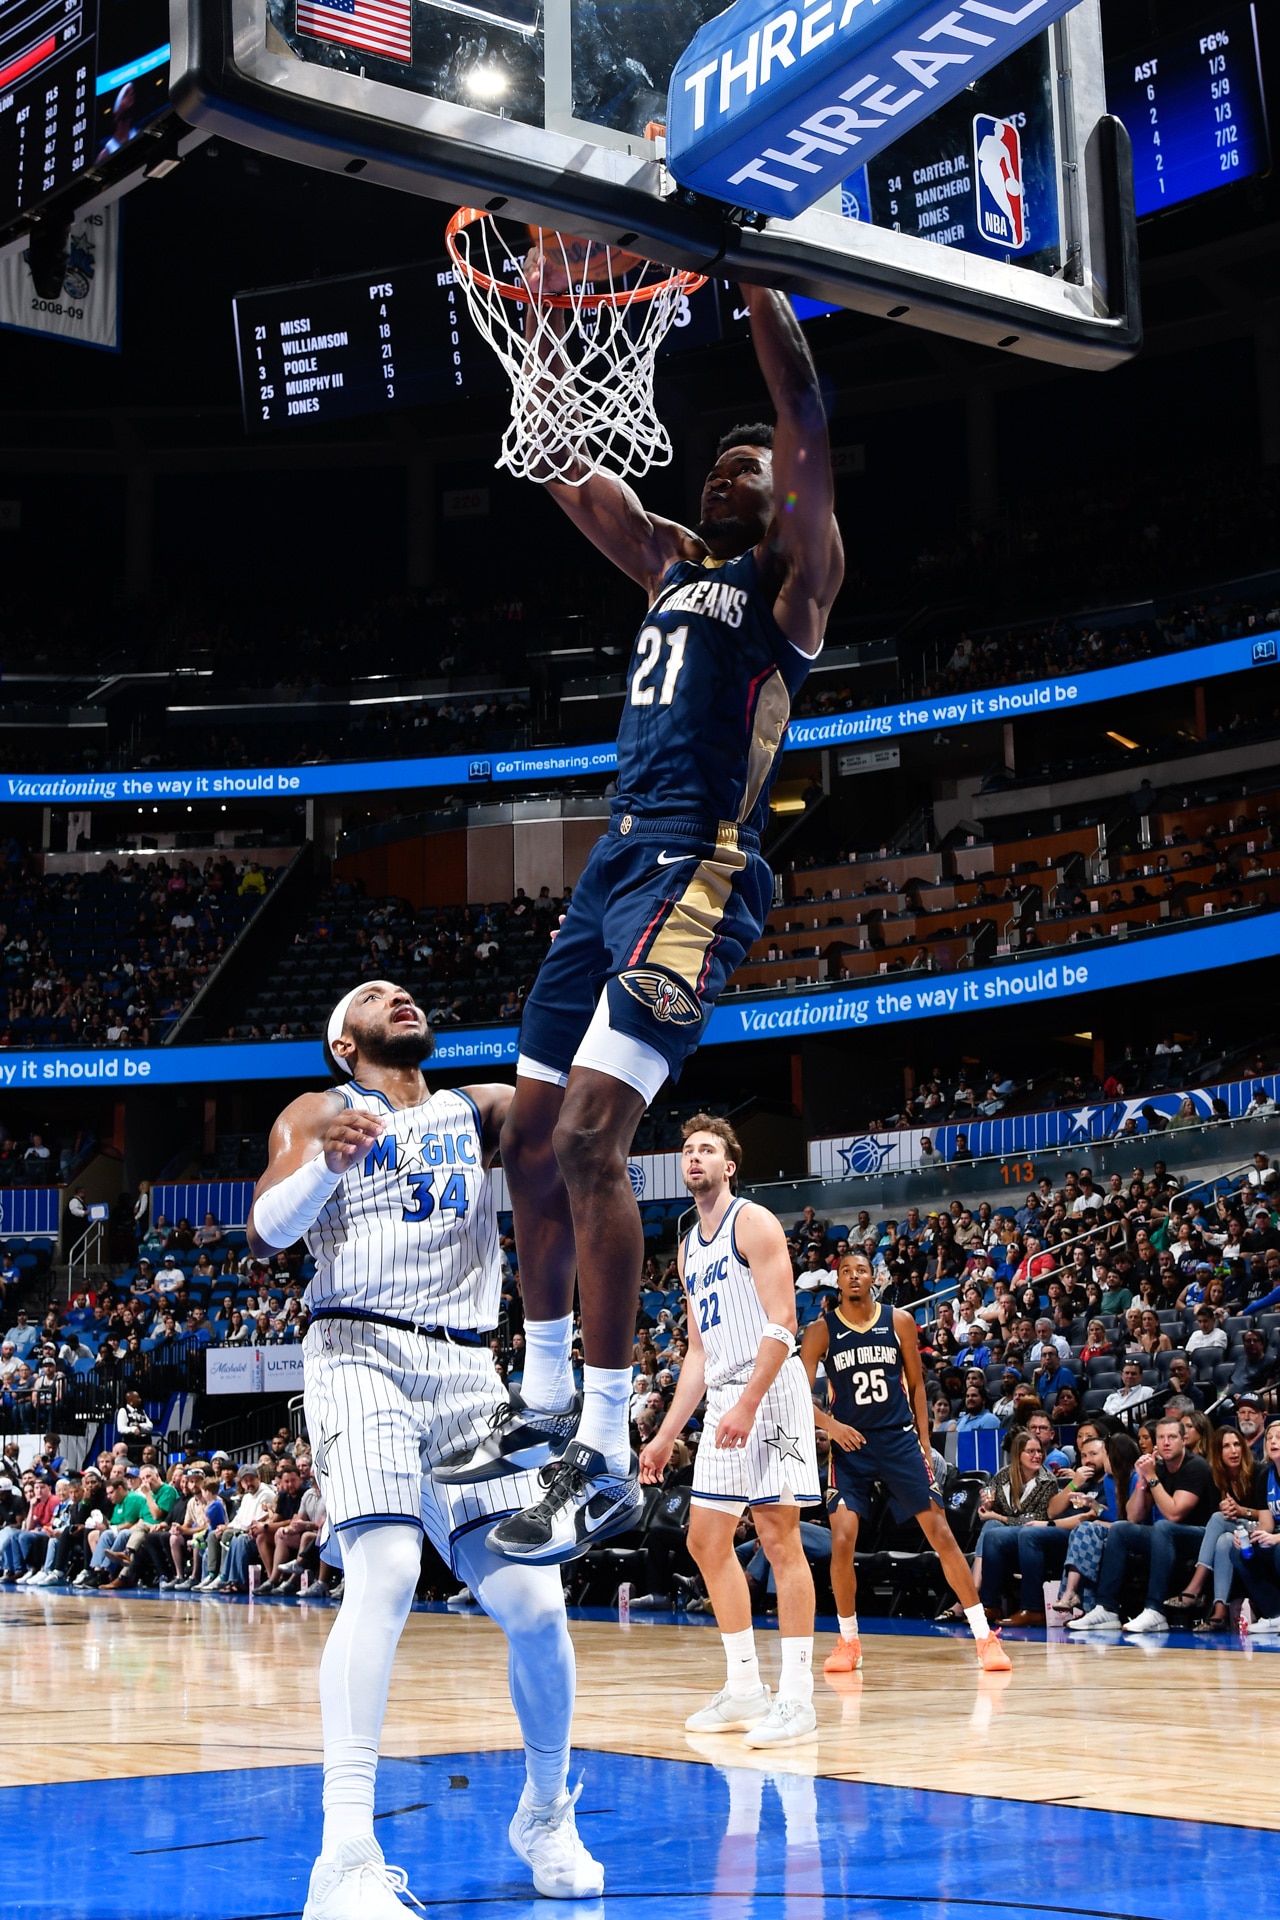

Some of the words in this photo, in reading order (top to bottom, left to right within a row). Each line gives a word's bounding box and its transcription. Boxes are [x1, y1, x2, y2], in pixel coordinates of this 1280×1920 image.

[1134, 59, 1158, 82] AST
[1200, 30, 1229, 55] FG%
[16, 105, 30, 124] AST
[46, 86, 58, 104] FLS
[76, 66, 86, 82] FG
[888, 176, 902, 193] 34
[913, 162, 953, 185] CARTER
[954, 155, 969, 173] JR.
[1147, 84, 1155, 100] 6
[1209, 55, 1226, 75] 1/3
[19, 144, 24, 155] 2
[890, 200, 898, 215] 5
[915, 177, 971, 208] BANCHERO
[1150, 108, 1158, 124] 2
[1211, 78, 1230, 99] 5/9
[918, 206, 949, 229] JONES
[1153, 131, 1160, 146] 4
[1214, 102, 1232, 123] 1/3
[1156, 154, 1163, 171] 2
[1215, 125, 1238, 148] 7/12
[18, 178, 22, 190] 2
[1159, 178, 1165, 193] 1
[1220, 150, 1239, 170] 2/6
[985, 212, 1008, 236] NBA
[369, 283, 393, 299] PTS
[503, 255, 525, 272] AST
[32, 298, 84, 320] 2008-09
[255, 325, 266, 340] 21
[280, 318, 310, 336] MISSI
[380, 304, 386, 317] 4
[448, 291, 455, 304] 4
[256, 347, 262, 360] 1
[282, 332, 348, 356] WILLIAMSON
[379, 324, 390, 338] 18
[450, 311, 457, 325] 5
[575, 282, 594, 295] 911
[259, 366, 266, 380] 3
[284, 358, 318, 376] POOLE
[382, 344, 392, 358] 21
[451, 331, 459, 345] 0
[519, 318, 524, 331] 1
[260, 385, 274, 400] 25
[286, 376, 330, 396] MURPHY
[332, 373, 343, 388] III
[382, 365, 394, 379] 15
[453, 351, 460, 365] 6
[262, 406, 270, 420] 2
[287, 398, 320, 416] JONES
[387, 385, 394, 399] 3
[455, 371, 462, 385] 3
[630, 625, 689, 706] 21
[787, 714, 892, 743] Vacationing
[898, 709, 929, 726] the
[932, 704, 967, 721] way
[971, 698, 984, 715] it
[988, 689, 1050, 712] should
[1055, 685, 1077, 701] be
[496, 753, 618, 772] GoTimesharing.com
[7, 778, 117, 798] Vacationing
[122, 778, 153, 794] the
[157, 777, 192, 796] way
[196, 776, 208, 792] it
[213, 774, 274, 791] should
[278, 774, 300, 790] be
[739, 999, 869, 1031] Vacationing
[876, 994, 912, 1014] the
[917, 986, 959, 1010] way
[963, 982, 978, 1001] it
[984, 969, 1057, 998] should
[1063, 965, 1088, 985] be
[0, 1065, 17, 1084] y
[22, 1061, 37, 1078] it
[43, 1059, 118, 1078] should
[124, 1058, 151, 1076] be
[430, 1042, 518, 1058] esharing.c
[364, 1134, 476, 1177] MGIC
[1000, 1161, 1034, 1184] 113
[402, 1172, 469, 1222] 34
[686, 1256, 728, 1296] MGIC
[700, 1292, 721, 1334] 22
[774, 1328, 789, 1342] 22
[268, 1360, 304, 1371] ULTRA
[833, 1349, 855, 1372] NEW
[857, 1346, 897, 1365] ORLEANS
[852, 1368, 889, 1405] 25
